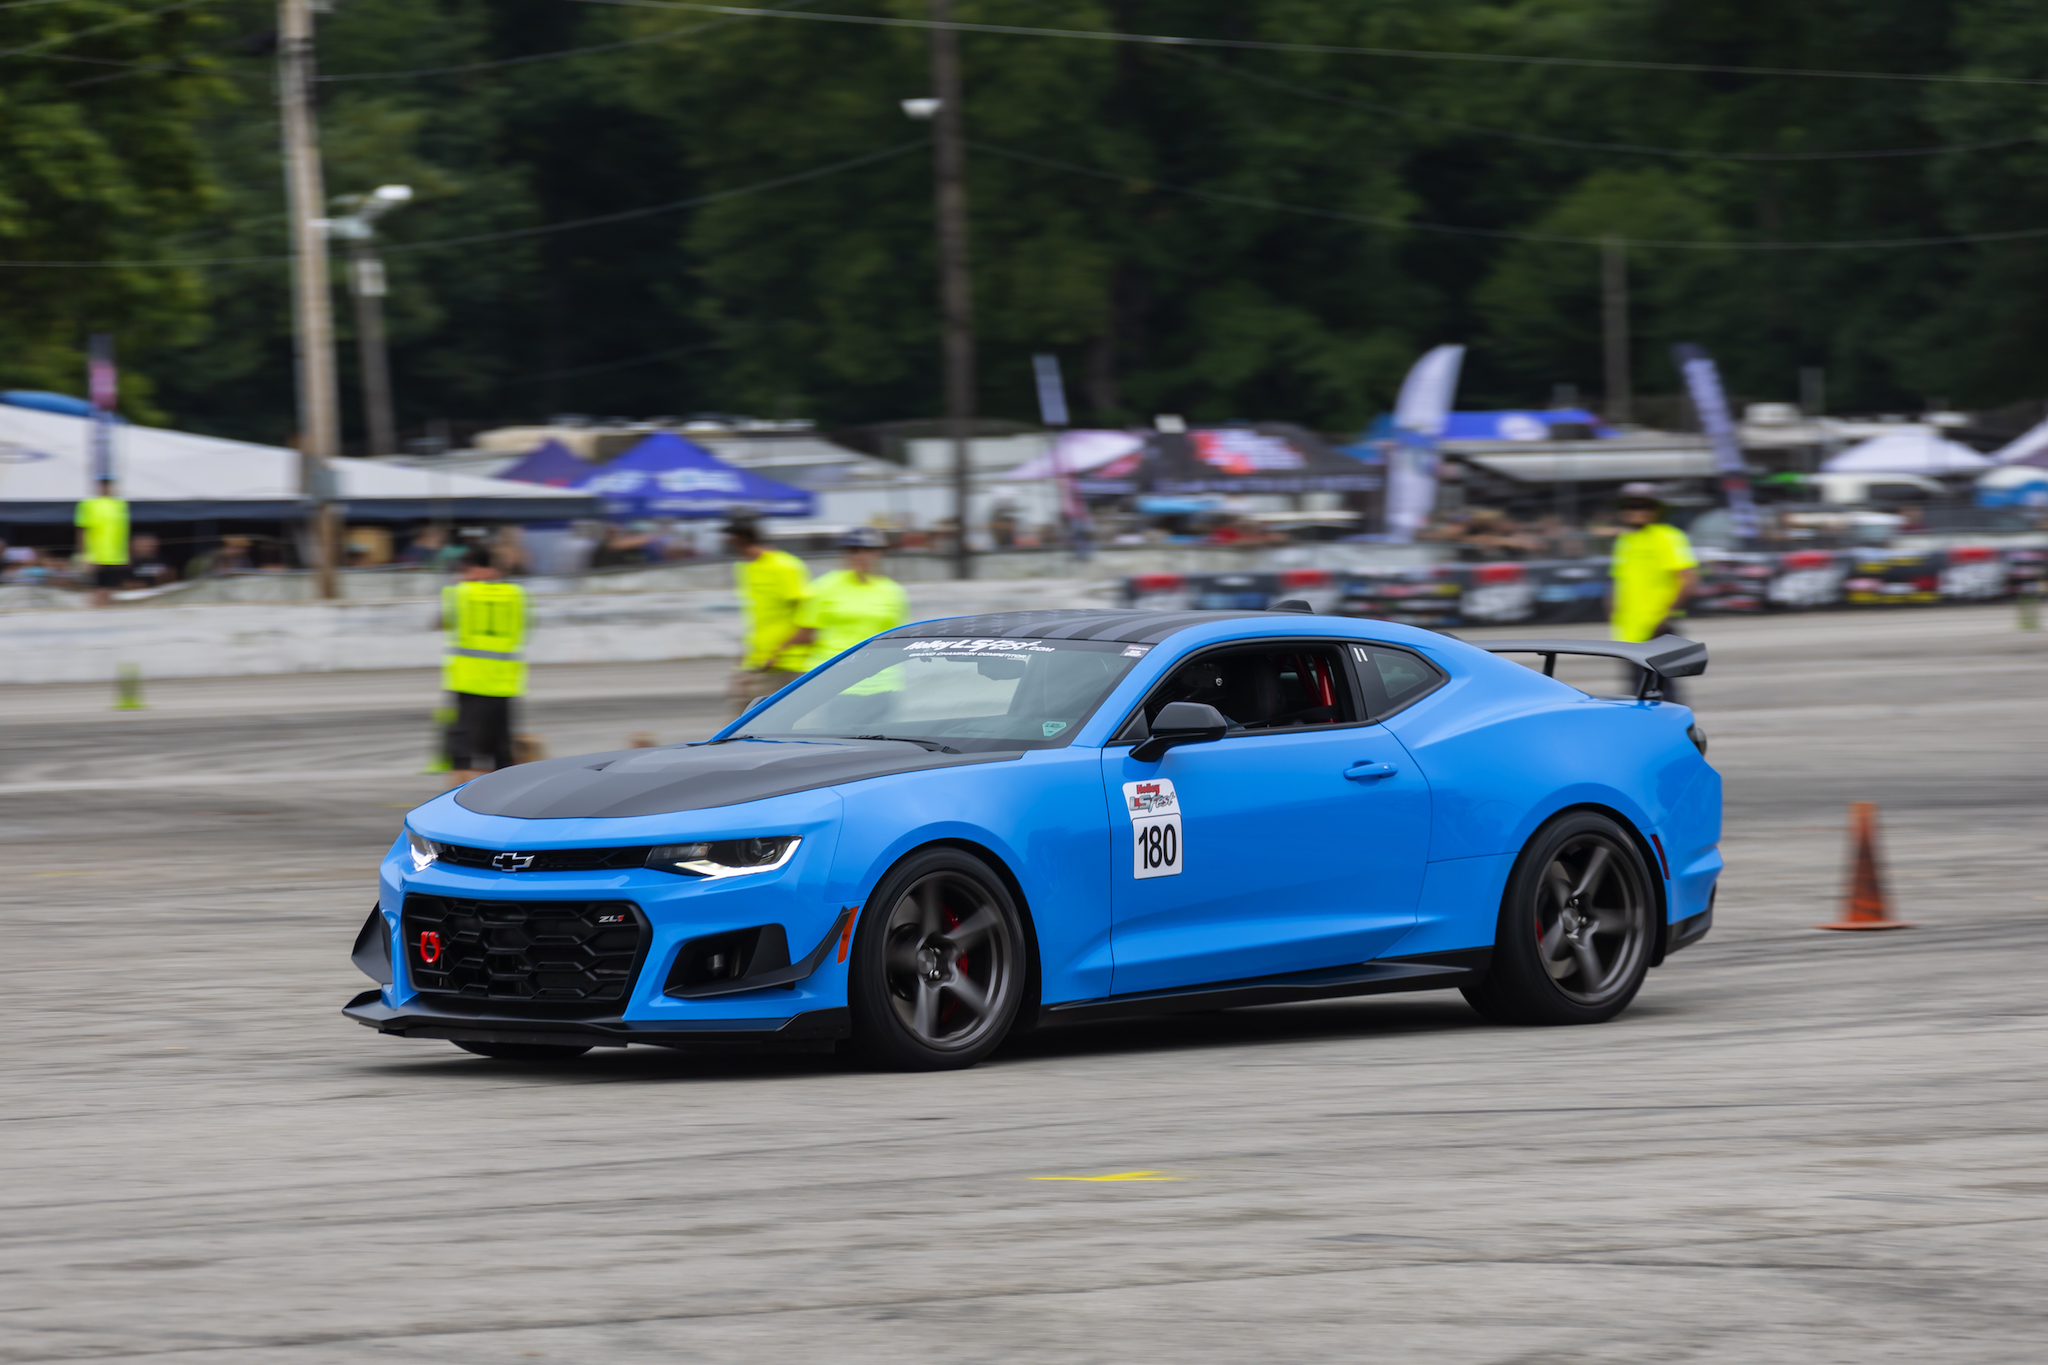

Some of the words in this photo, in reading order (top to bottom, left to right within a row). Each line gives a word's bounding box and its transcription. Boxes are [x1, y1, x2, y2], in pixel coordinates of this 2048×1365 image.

[1136, 783, 1160, 796] Holley
[1138, 823, 1177, 869] 180
[598, 913, 625, 923] ZL1
